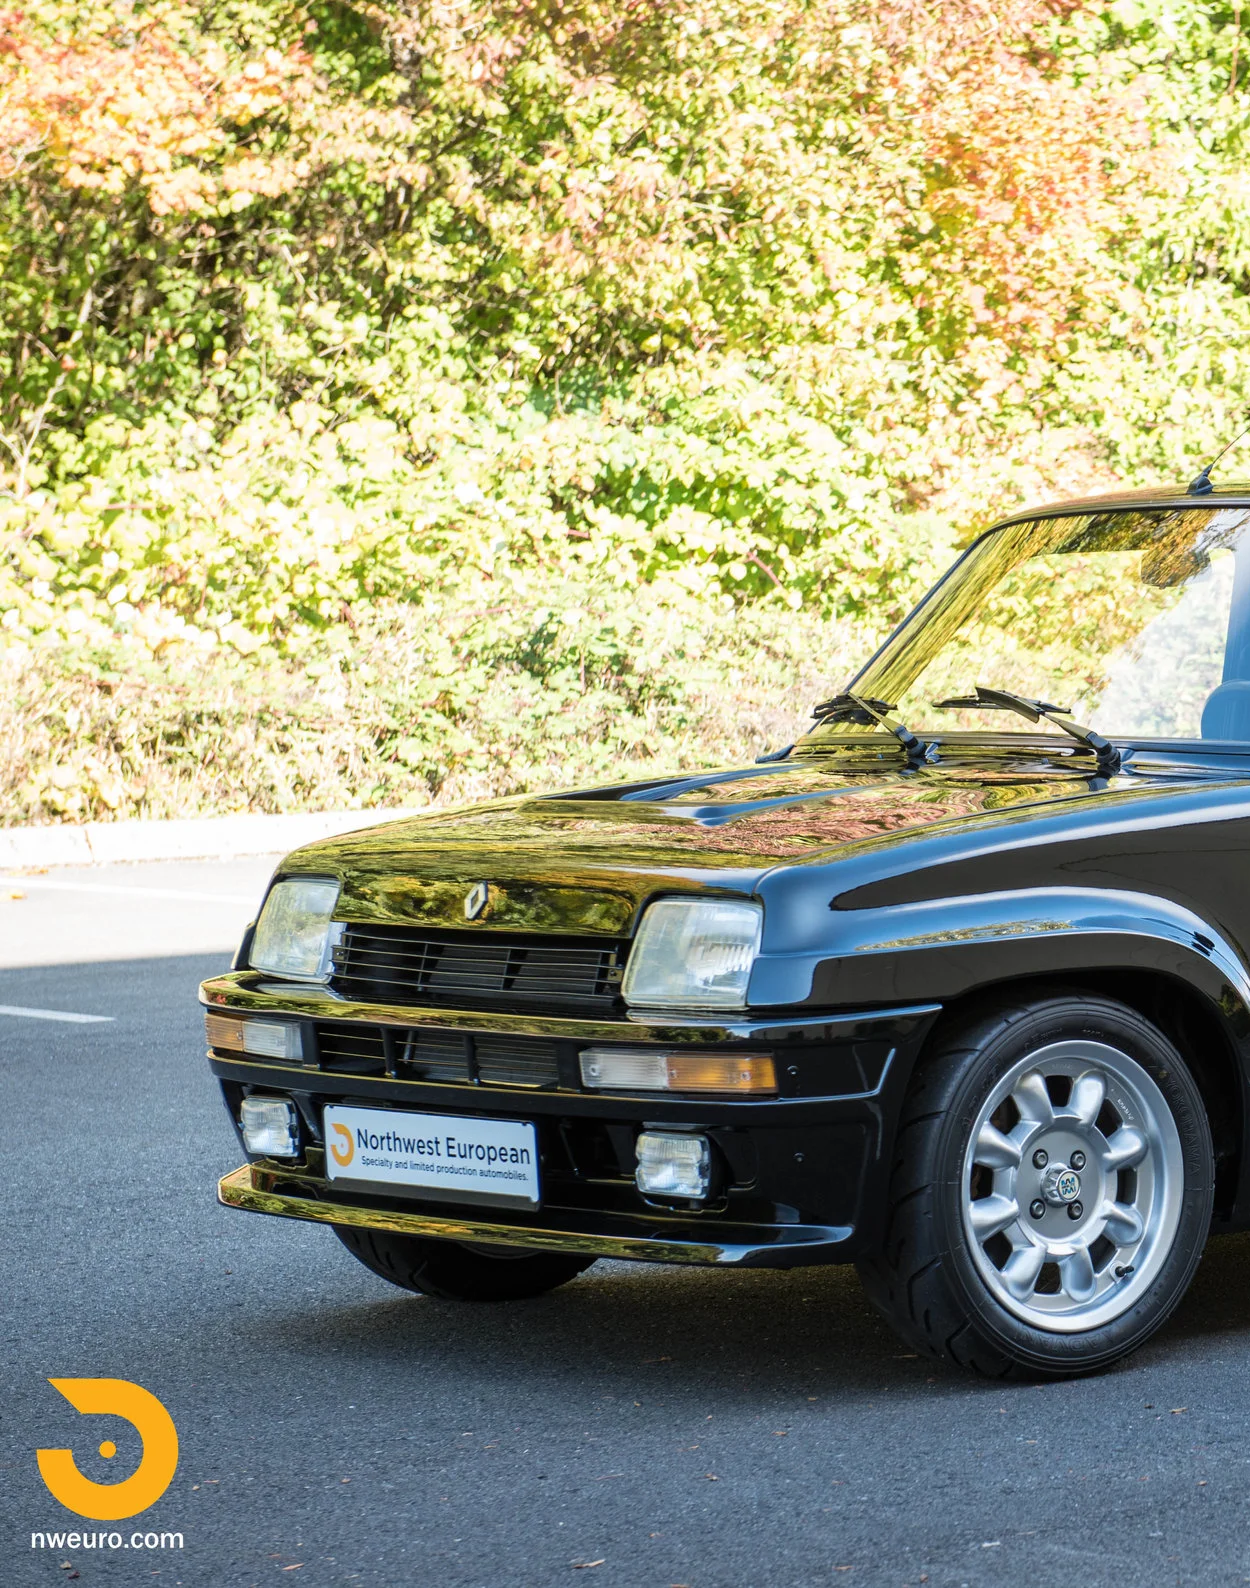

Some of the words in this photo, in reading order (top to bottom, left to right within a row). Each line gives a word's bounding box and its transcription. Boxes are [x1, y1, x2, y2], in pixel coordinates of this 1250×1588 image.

[357, 1128, 441, 1157] Northwest
[446, 1137, 530, 1165] European
[361, 1155, 393, 1170] Specialty
[395, 1159, 408, 1170] and
[409, 1160, 435, 1172] limited
[436, 1163, 478, 1176] production
[479, 1169, 529, 1181] automobiles.
